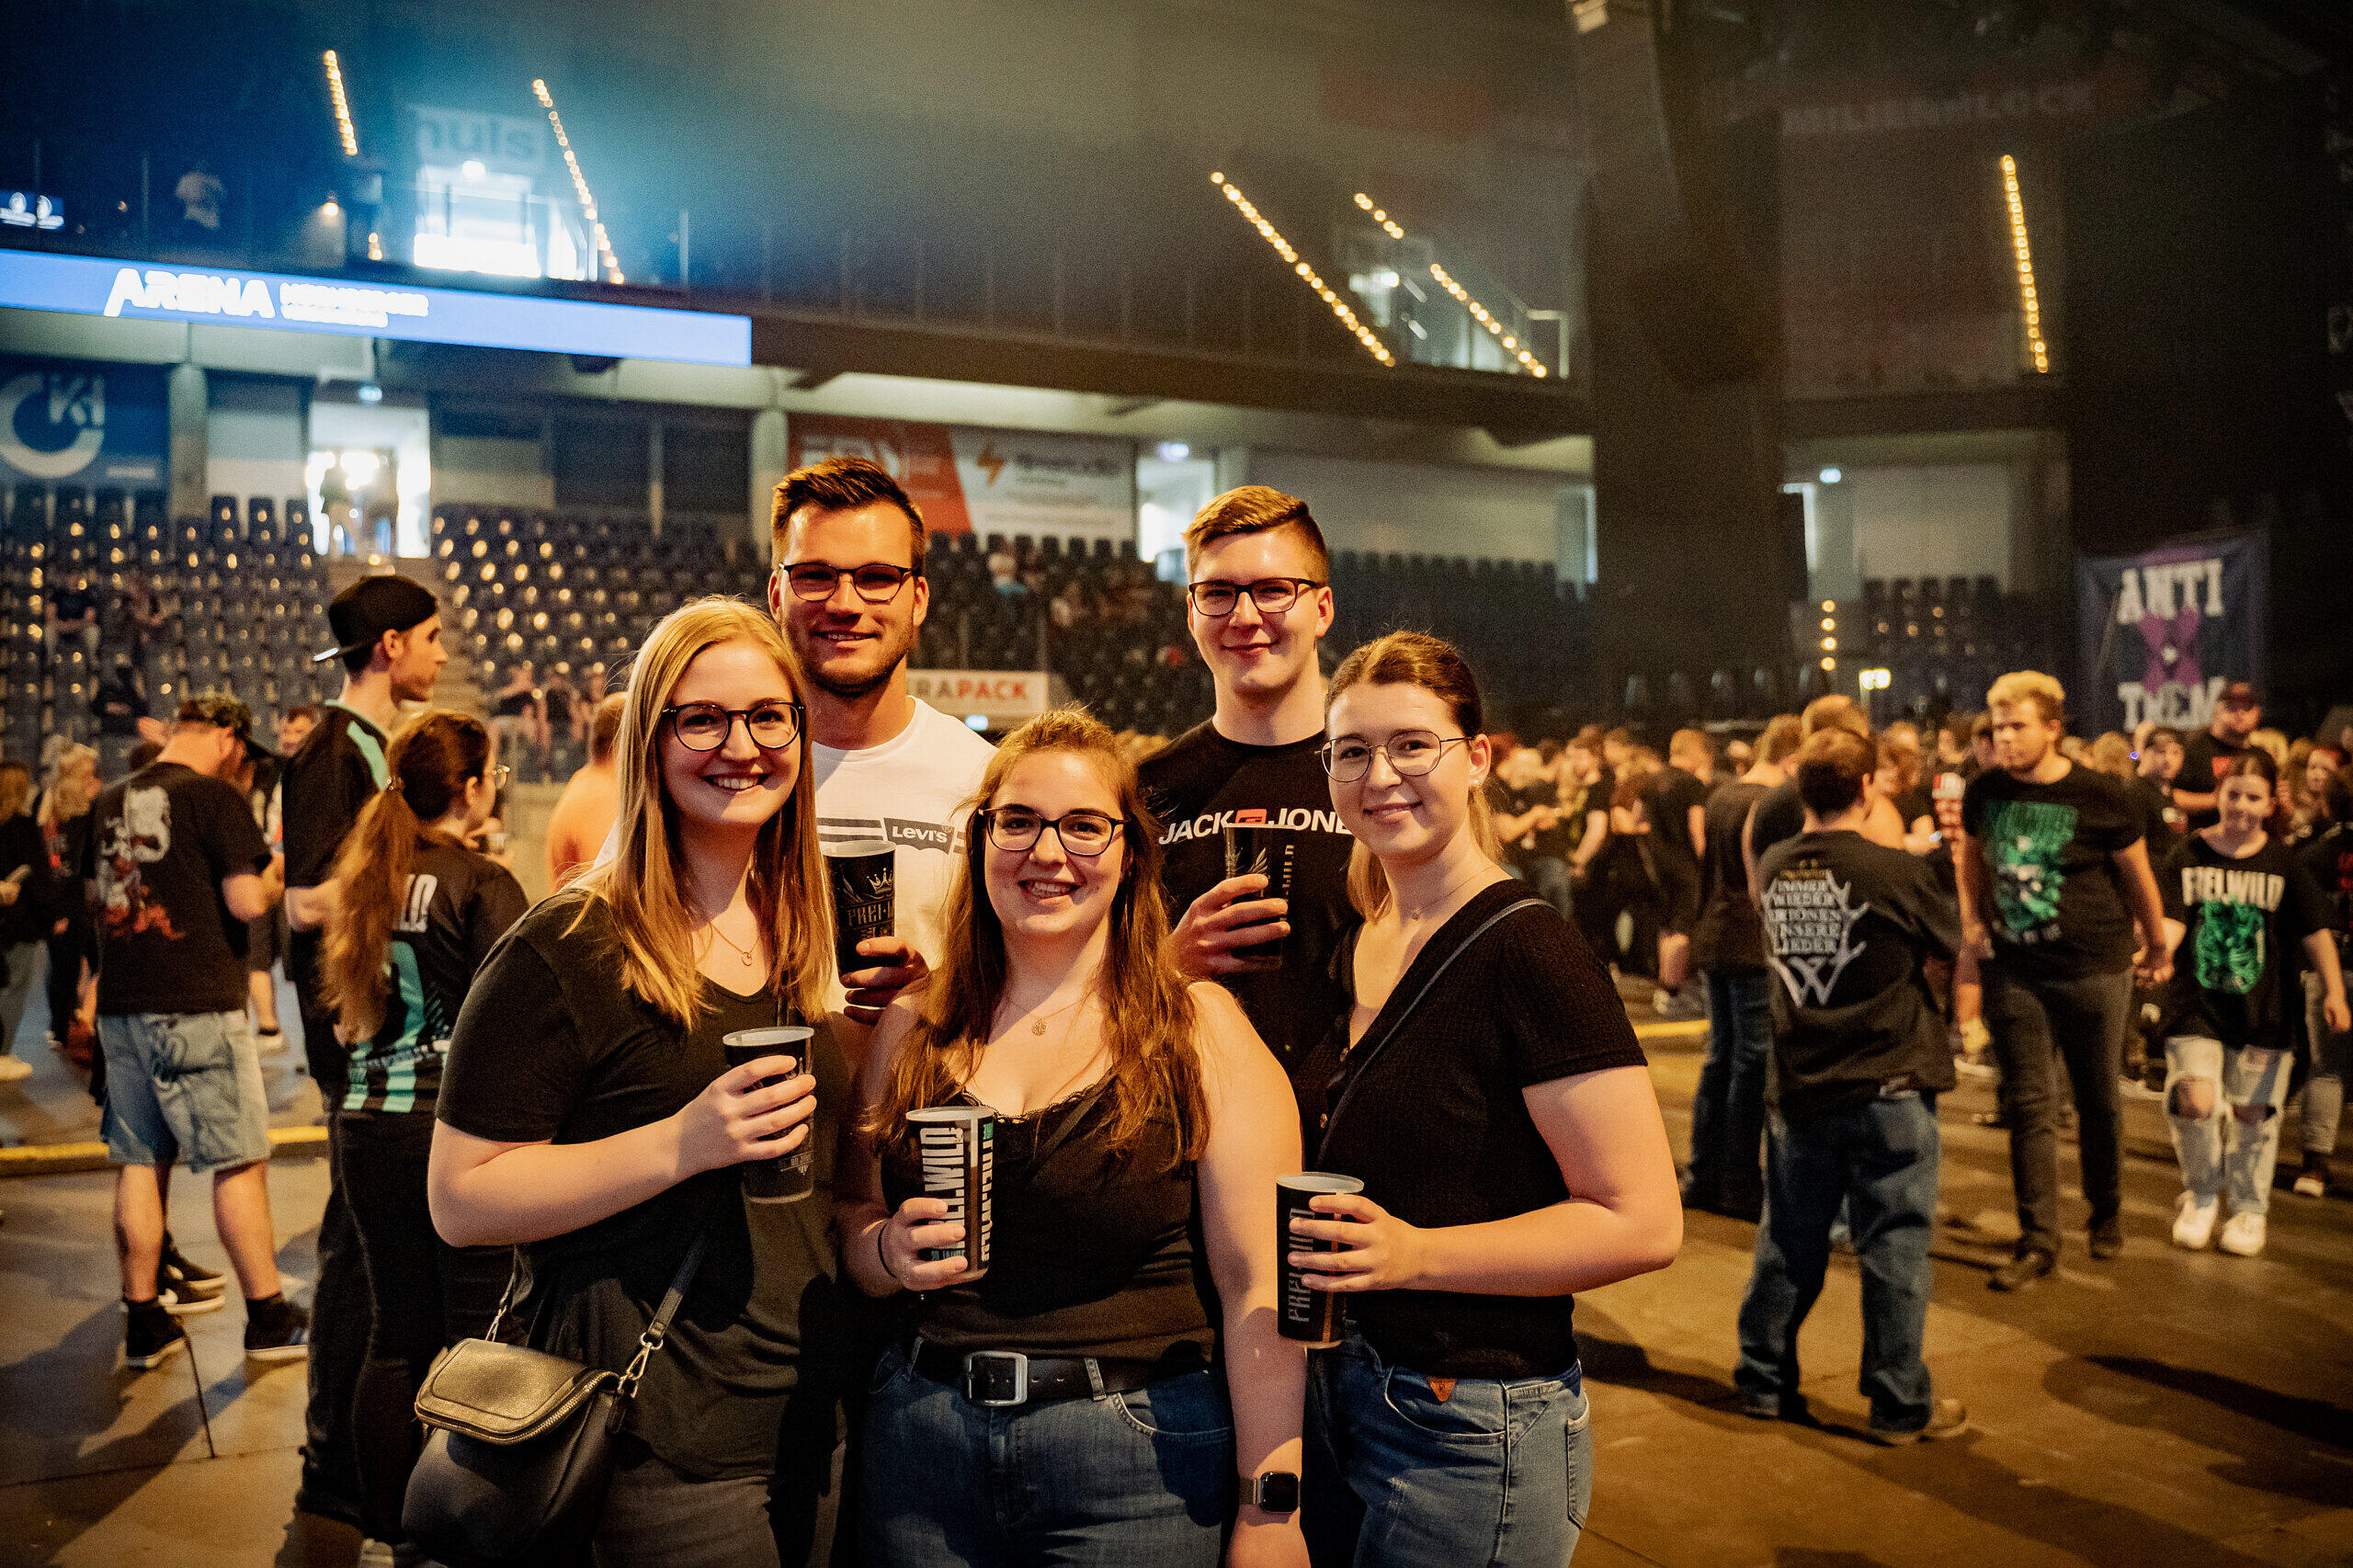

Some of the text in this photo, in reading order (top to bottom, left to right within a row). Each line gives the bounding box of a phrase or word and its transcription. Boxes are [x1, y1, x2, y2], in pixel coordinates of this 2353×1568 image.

[103, 268, 276, 319] ARENA
[2117, 558, 2224, 624] ANTI
[1158, 810, 1234, 846] JACK
[1267, 808, 1353, 835] JONE
